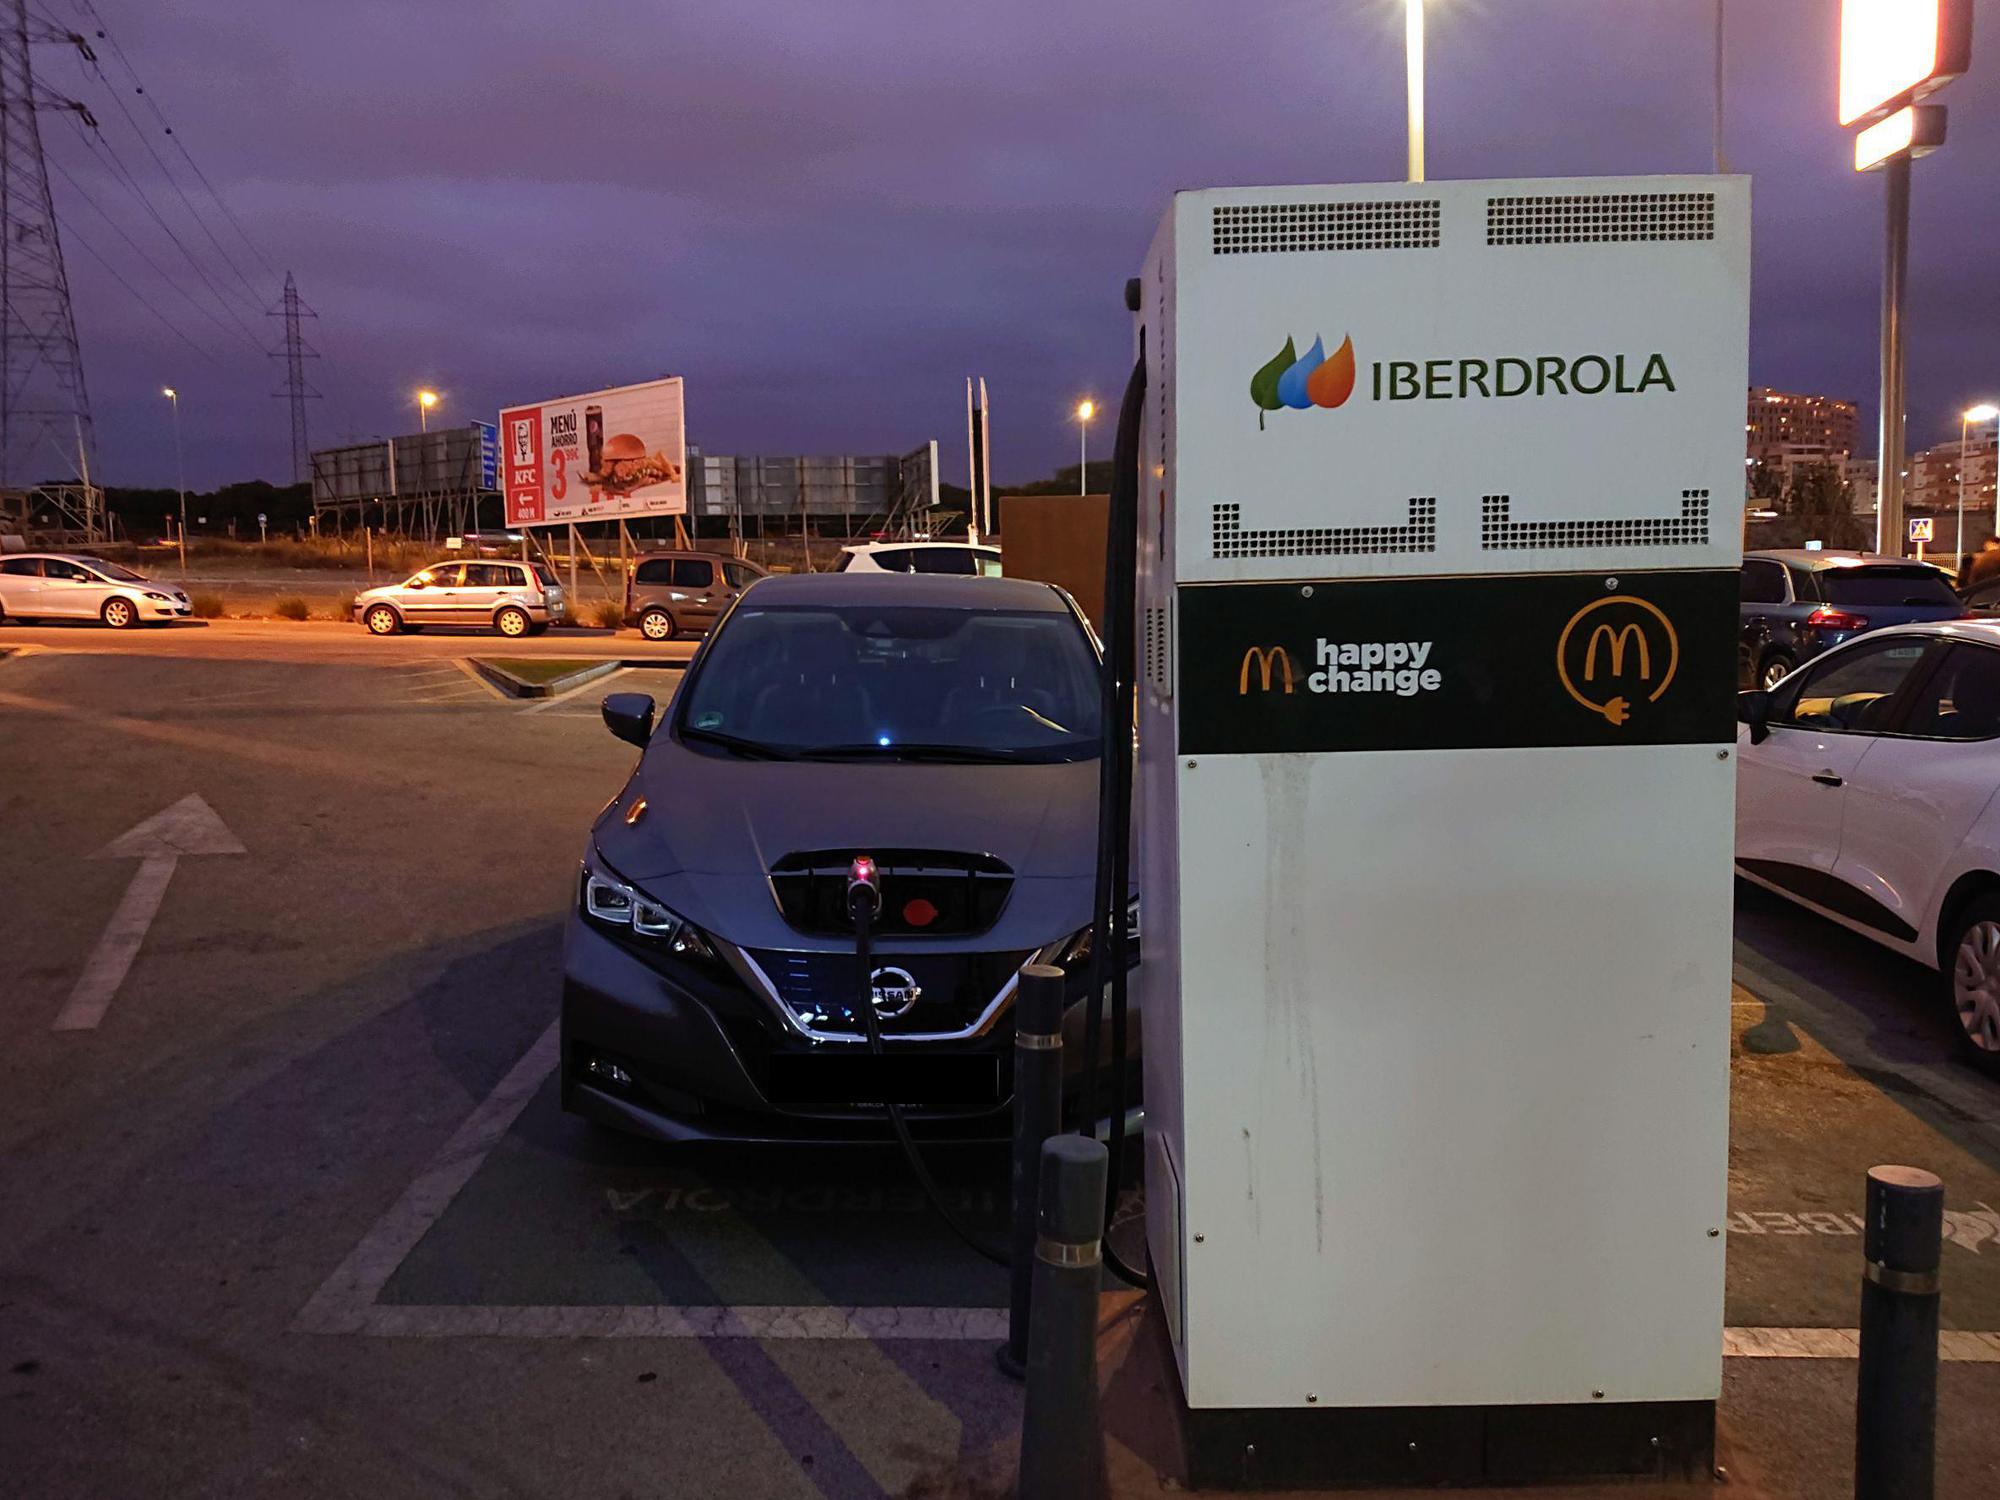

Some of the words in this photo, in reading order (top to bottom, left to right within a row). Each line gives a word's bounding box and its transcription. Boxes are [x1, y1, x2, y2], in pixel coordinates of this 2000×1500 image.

[1372, 353, 1676, 401] IBERDROLA
[550, 409, 577, 434] MENÚ
[552, 432, 578, 448] AHORRO
[515, 469, 536, 485] KFC
[1316, 638, 1433, 670] happy
[1307, 663, 1442, 696] change
[871, 990, 914, 1000] ISSAN
